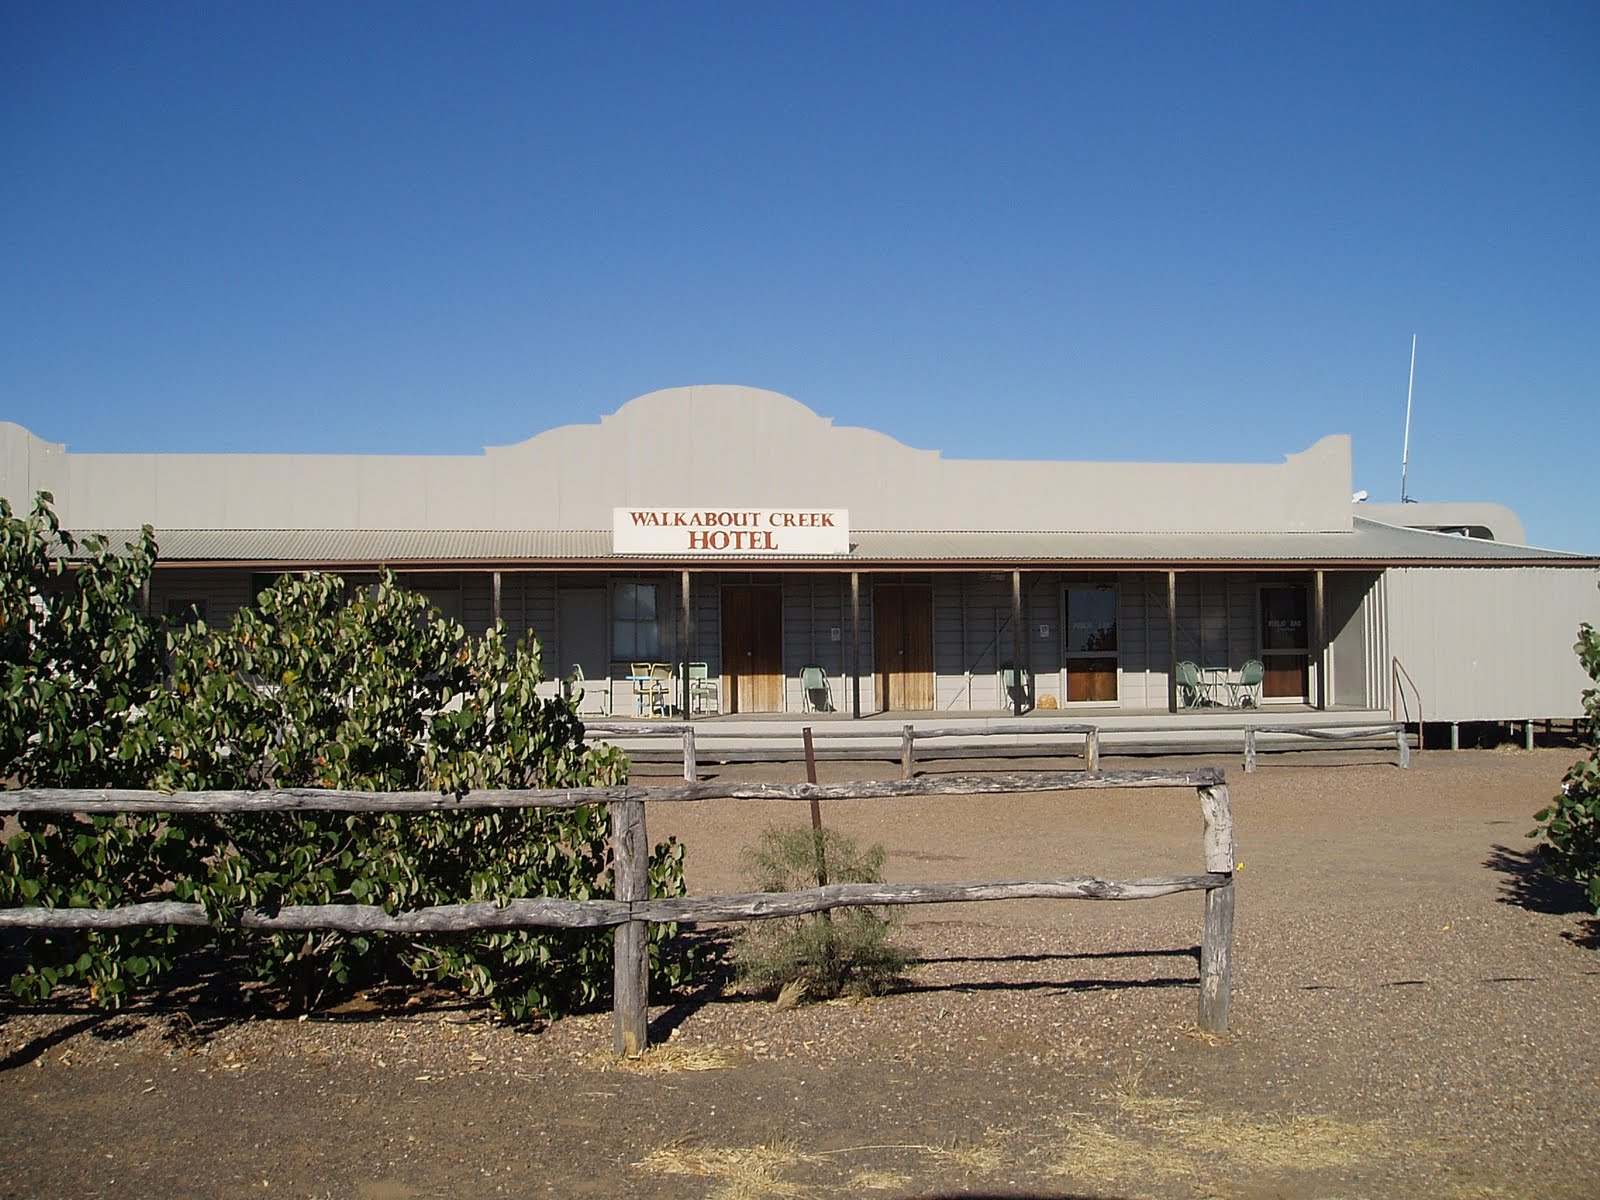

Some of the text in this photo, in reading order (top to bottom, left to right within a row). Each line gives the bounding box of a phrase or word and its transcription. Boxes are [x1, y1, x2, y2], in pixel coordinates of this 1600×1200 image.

[630, 511, 835, 527] WALKABOUT CREEK
[687, 530, 778, 550] HOTEL
